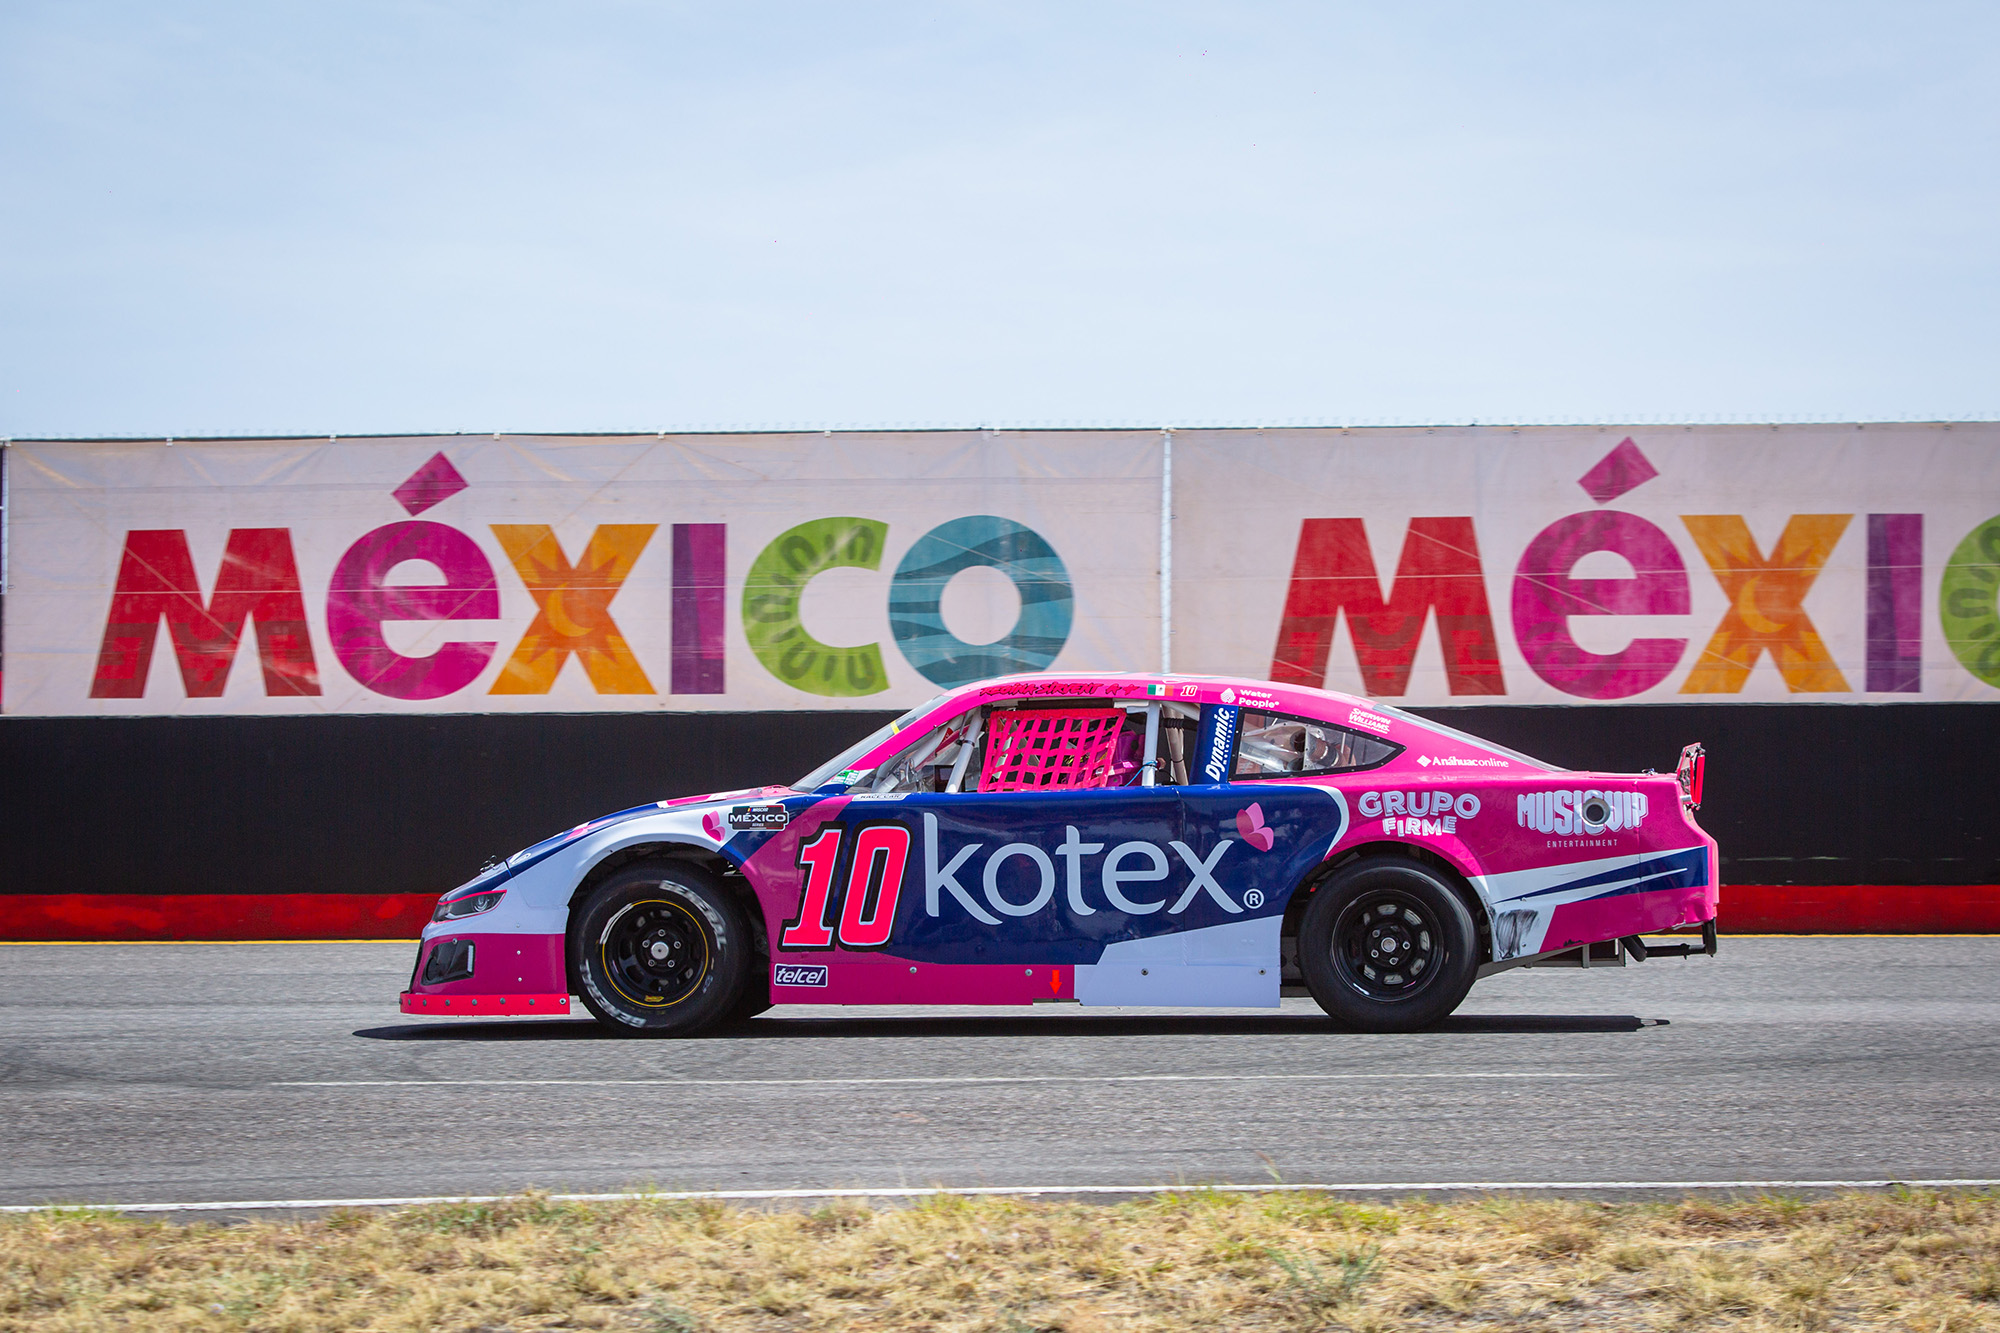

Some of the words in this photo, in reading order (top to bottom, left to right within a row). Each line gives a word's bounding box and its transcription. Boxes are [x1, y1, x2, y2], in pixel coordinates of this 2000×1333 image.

[1180, 685, 1198, 697] 10
[1240, 689, 1272, 699] Water
[1352, 708, 1391, 724] SHERWIN
[1205, 707, 1230, 782] Dynamic
[1358, 790, 1481, 819] GRUPO
[729, 812, 787, 822] MÉXICO
[1382, 815, 1457, 838] FIRME
[1546, 839, 1618, 848] ENTERTAINMENT
[779, 822, 913, 951] 10
[776, 967, 825, 984] telcel
